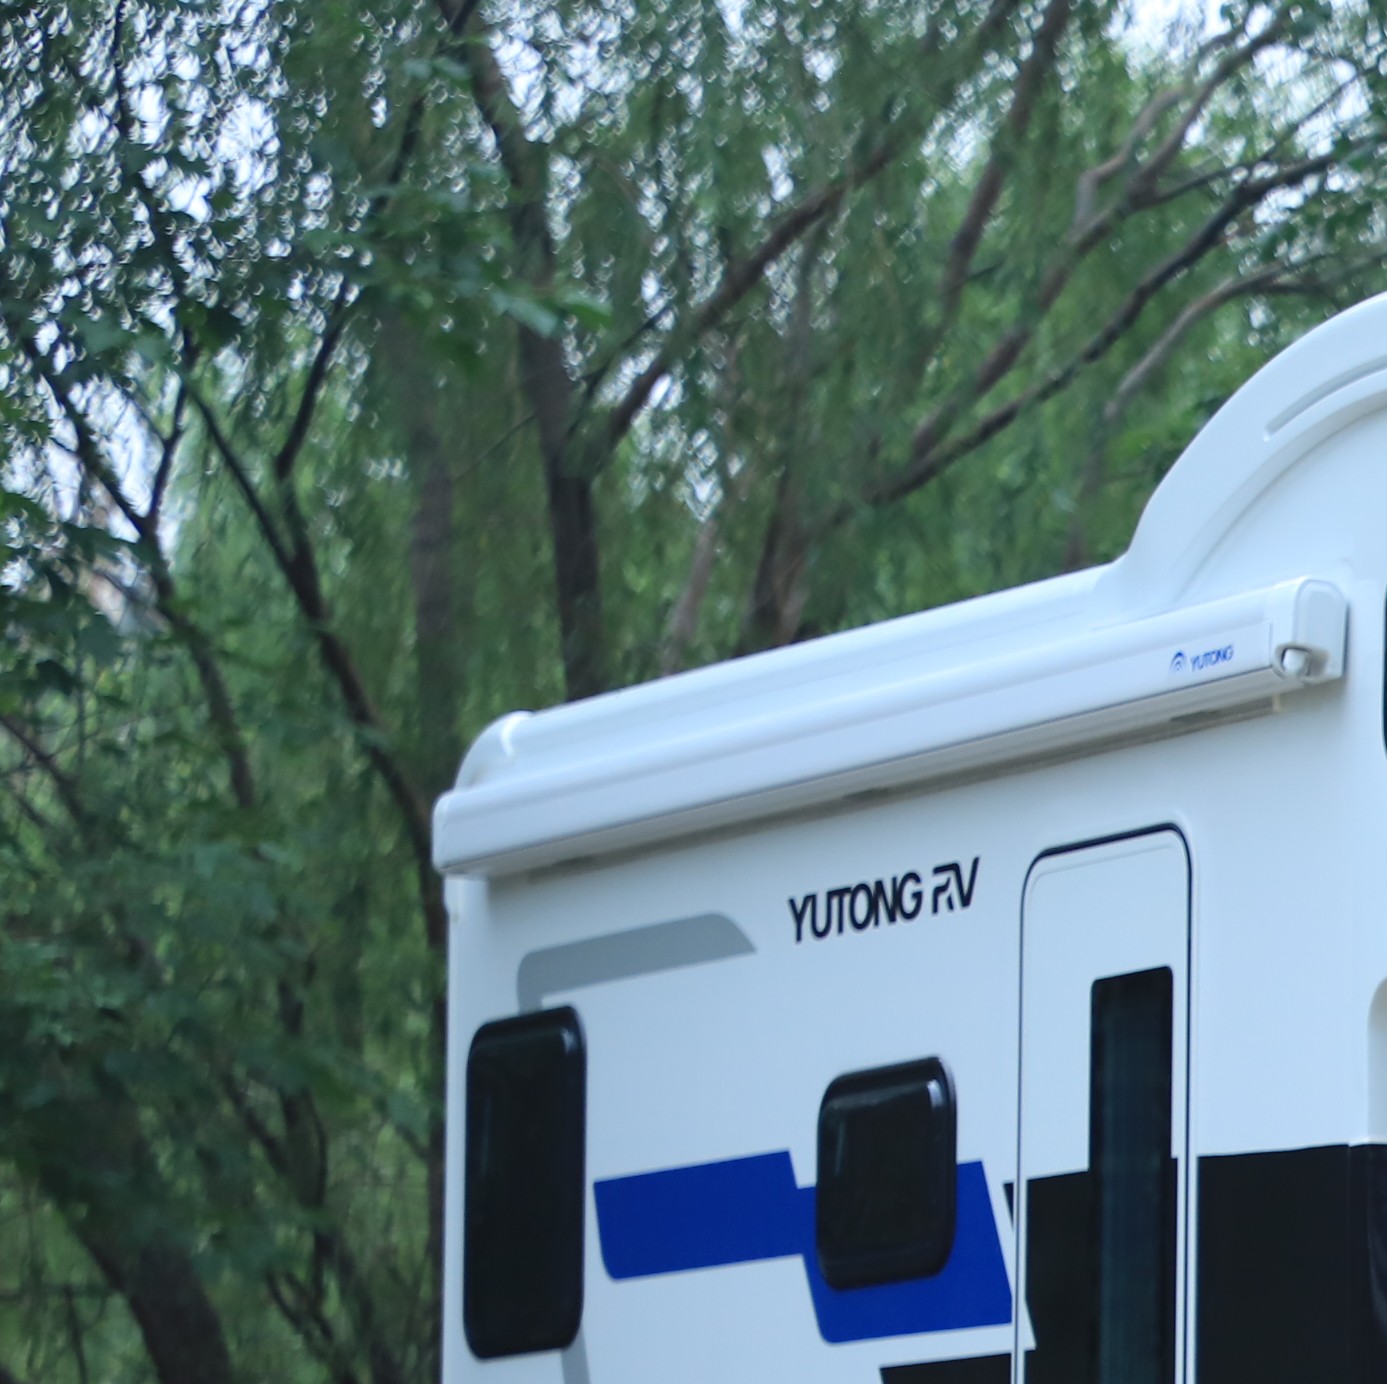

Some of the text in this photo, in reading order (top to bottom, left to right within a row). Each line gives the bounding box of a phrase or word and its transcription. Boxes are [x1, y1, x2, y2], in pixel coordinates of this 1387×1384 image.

[1189, 644, 1235, 673] YUTONG
[788, 855, 981, 944] YUTONG RV
